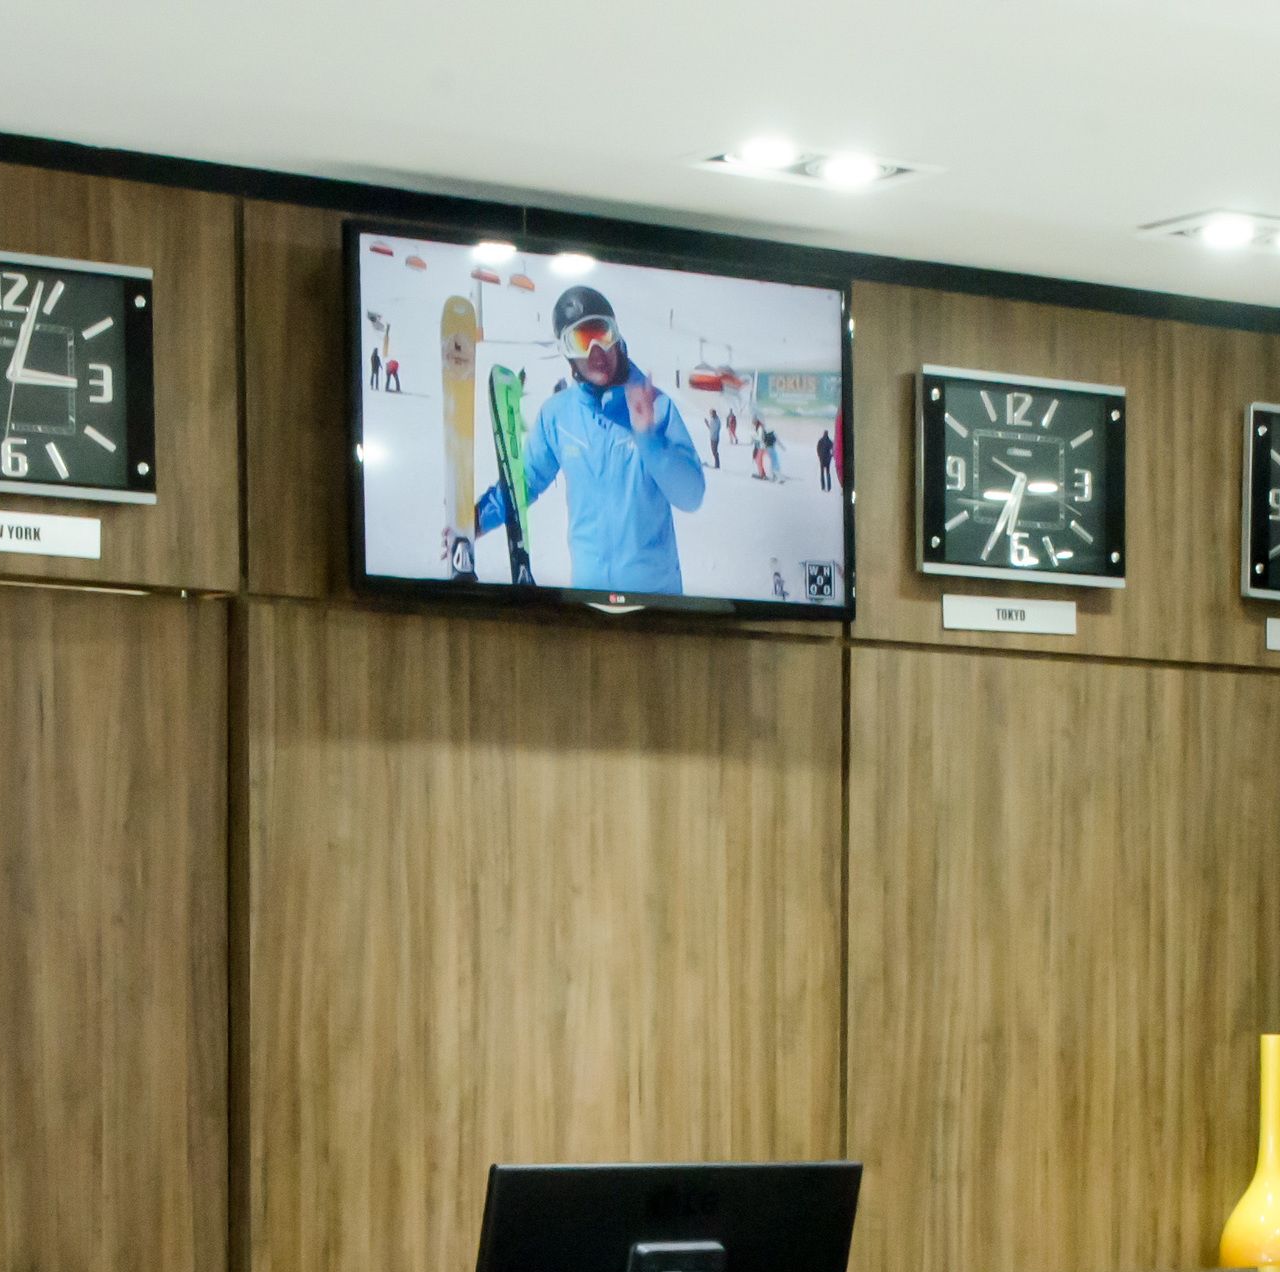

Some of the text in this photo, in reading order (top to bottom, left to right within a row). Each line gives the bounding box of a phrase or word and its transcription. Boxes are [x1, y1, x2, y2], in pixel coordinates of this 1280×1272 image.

[88, 363, 113, 403] 3
[1006, 392, 1033, 426] 12
[1, 437, 28, 477] 6
[946, 455, 966, 491] 9
[1074, 468, 1092, 502] 3
[8, 525, 41, 541] YORK
[1010, 532, 1031, 566] 6
[996, 608, 1026, 621] TOKYO
